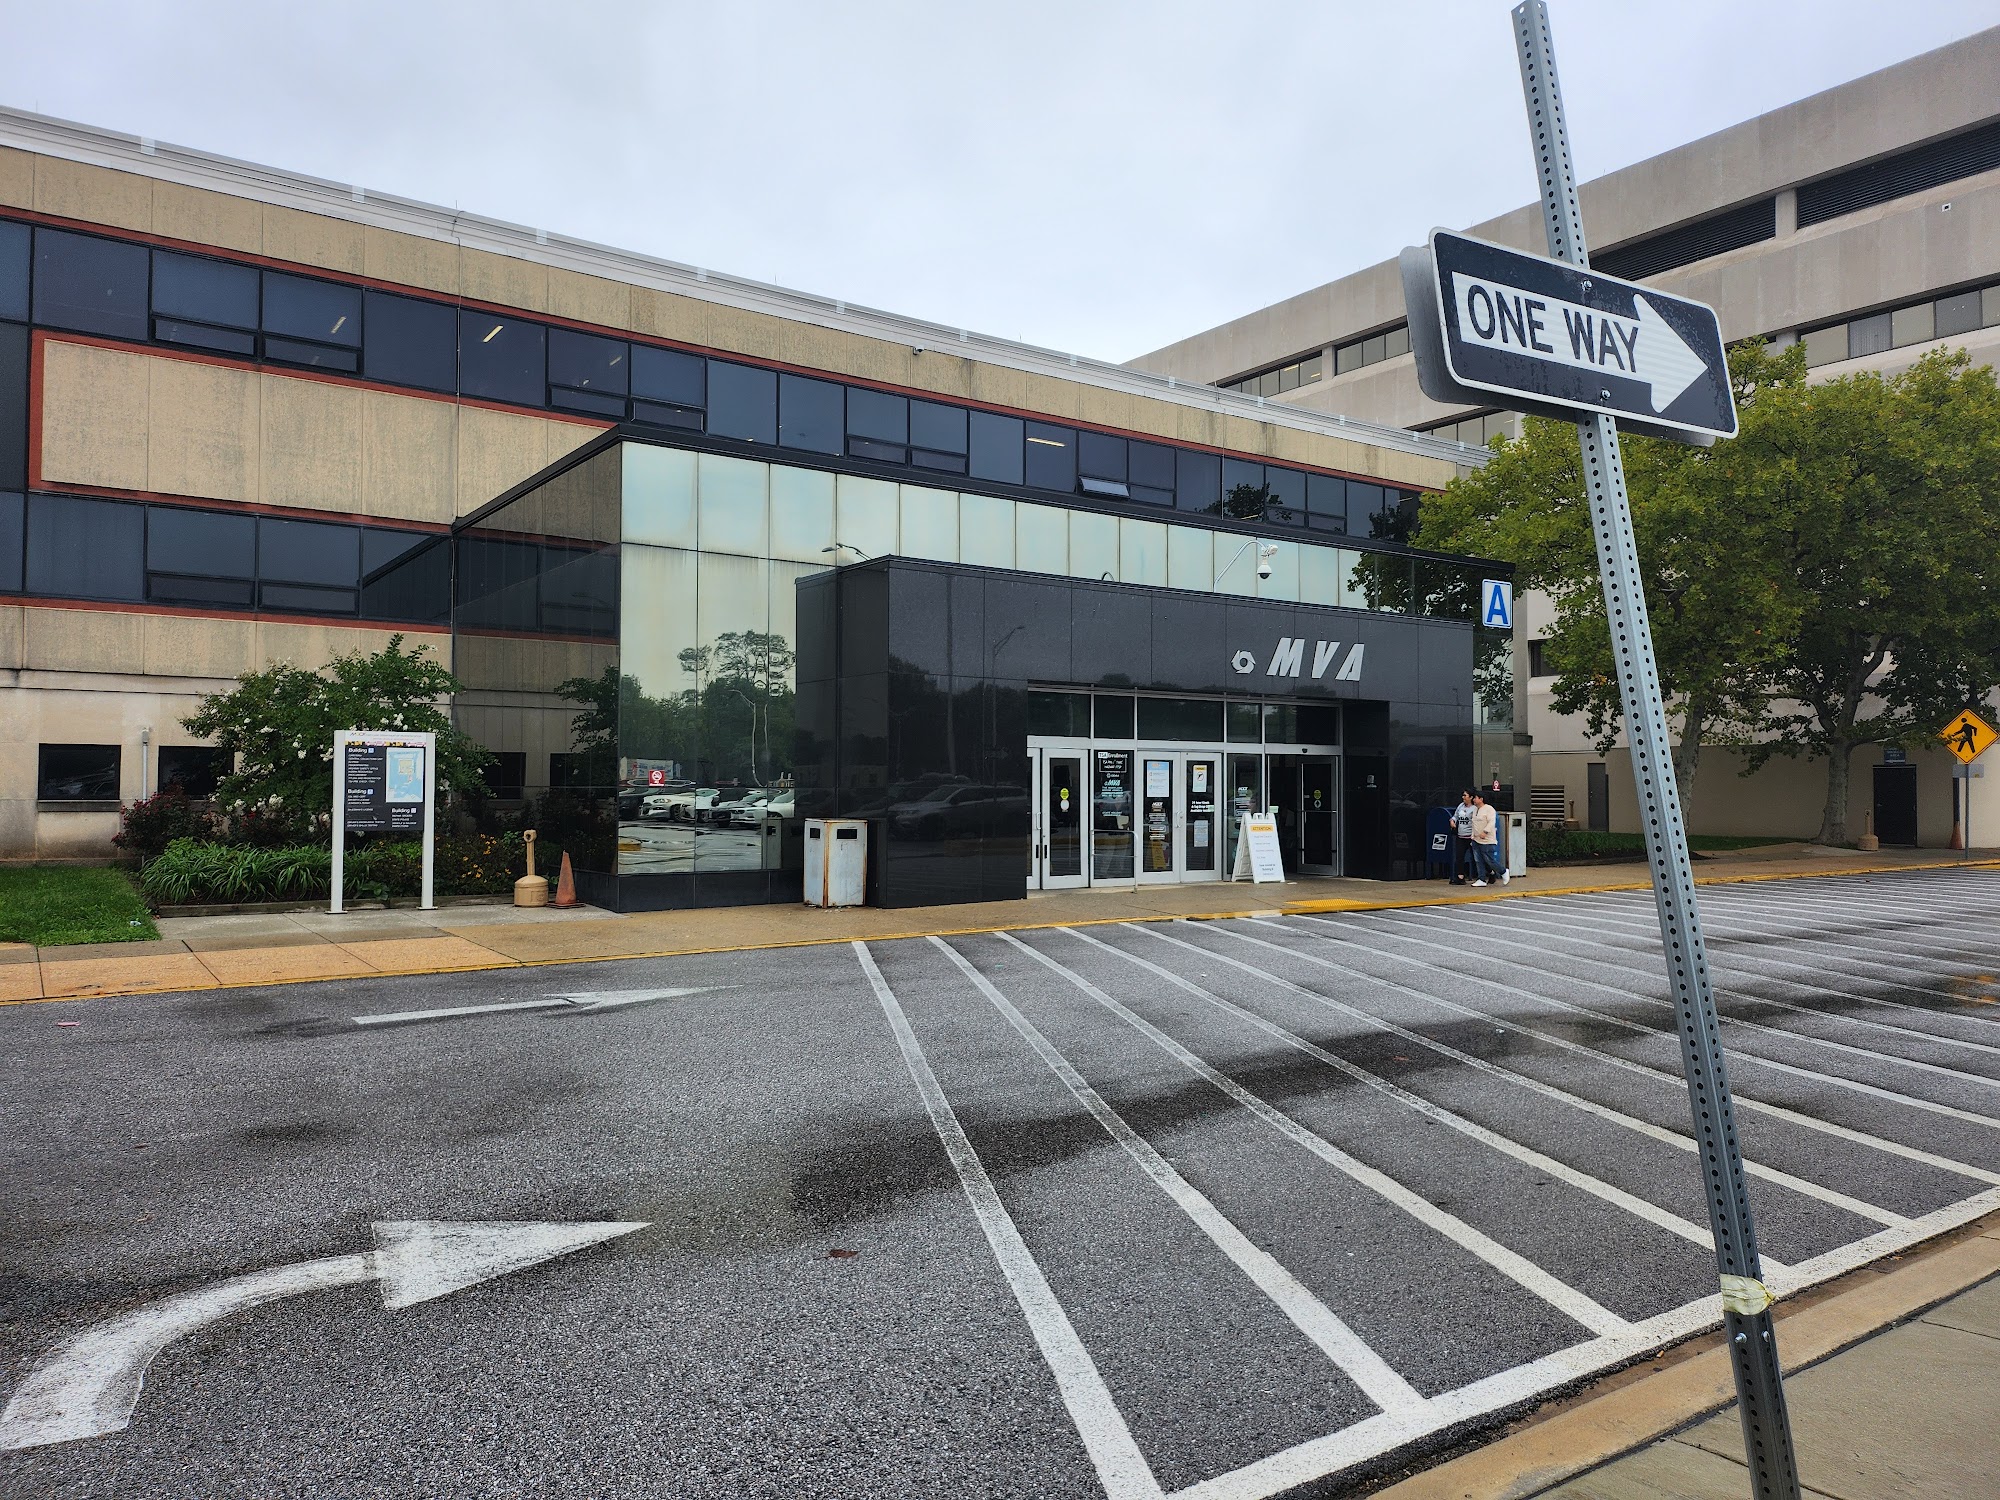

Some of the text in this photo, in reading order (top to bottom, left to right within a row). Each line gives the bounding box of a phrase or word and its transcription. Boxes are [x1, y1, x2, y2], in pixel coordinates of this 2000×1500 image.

[1467, 284, 1640, 374] ONE WAY
[1486, 584, 1509, 625] A
[1266, 637, 1365, 682] MVA
